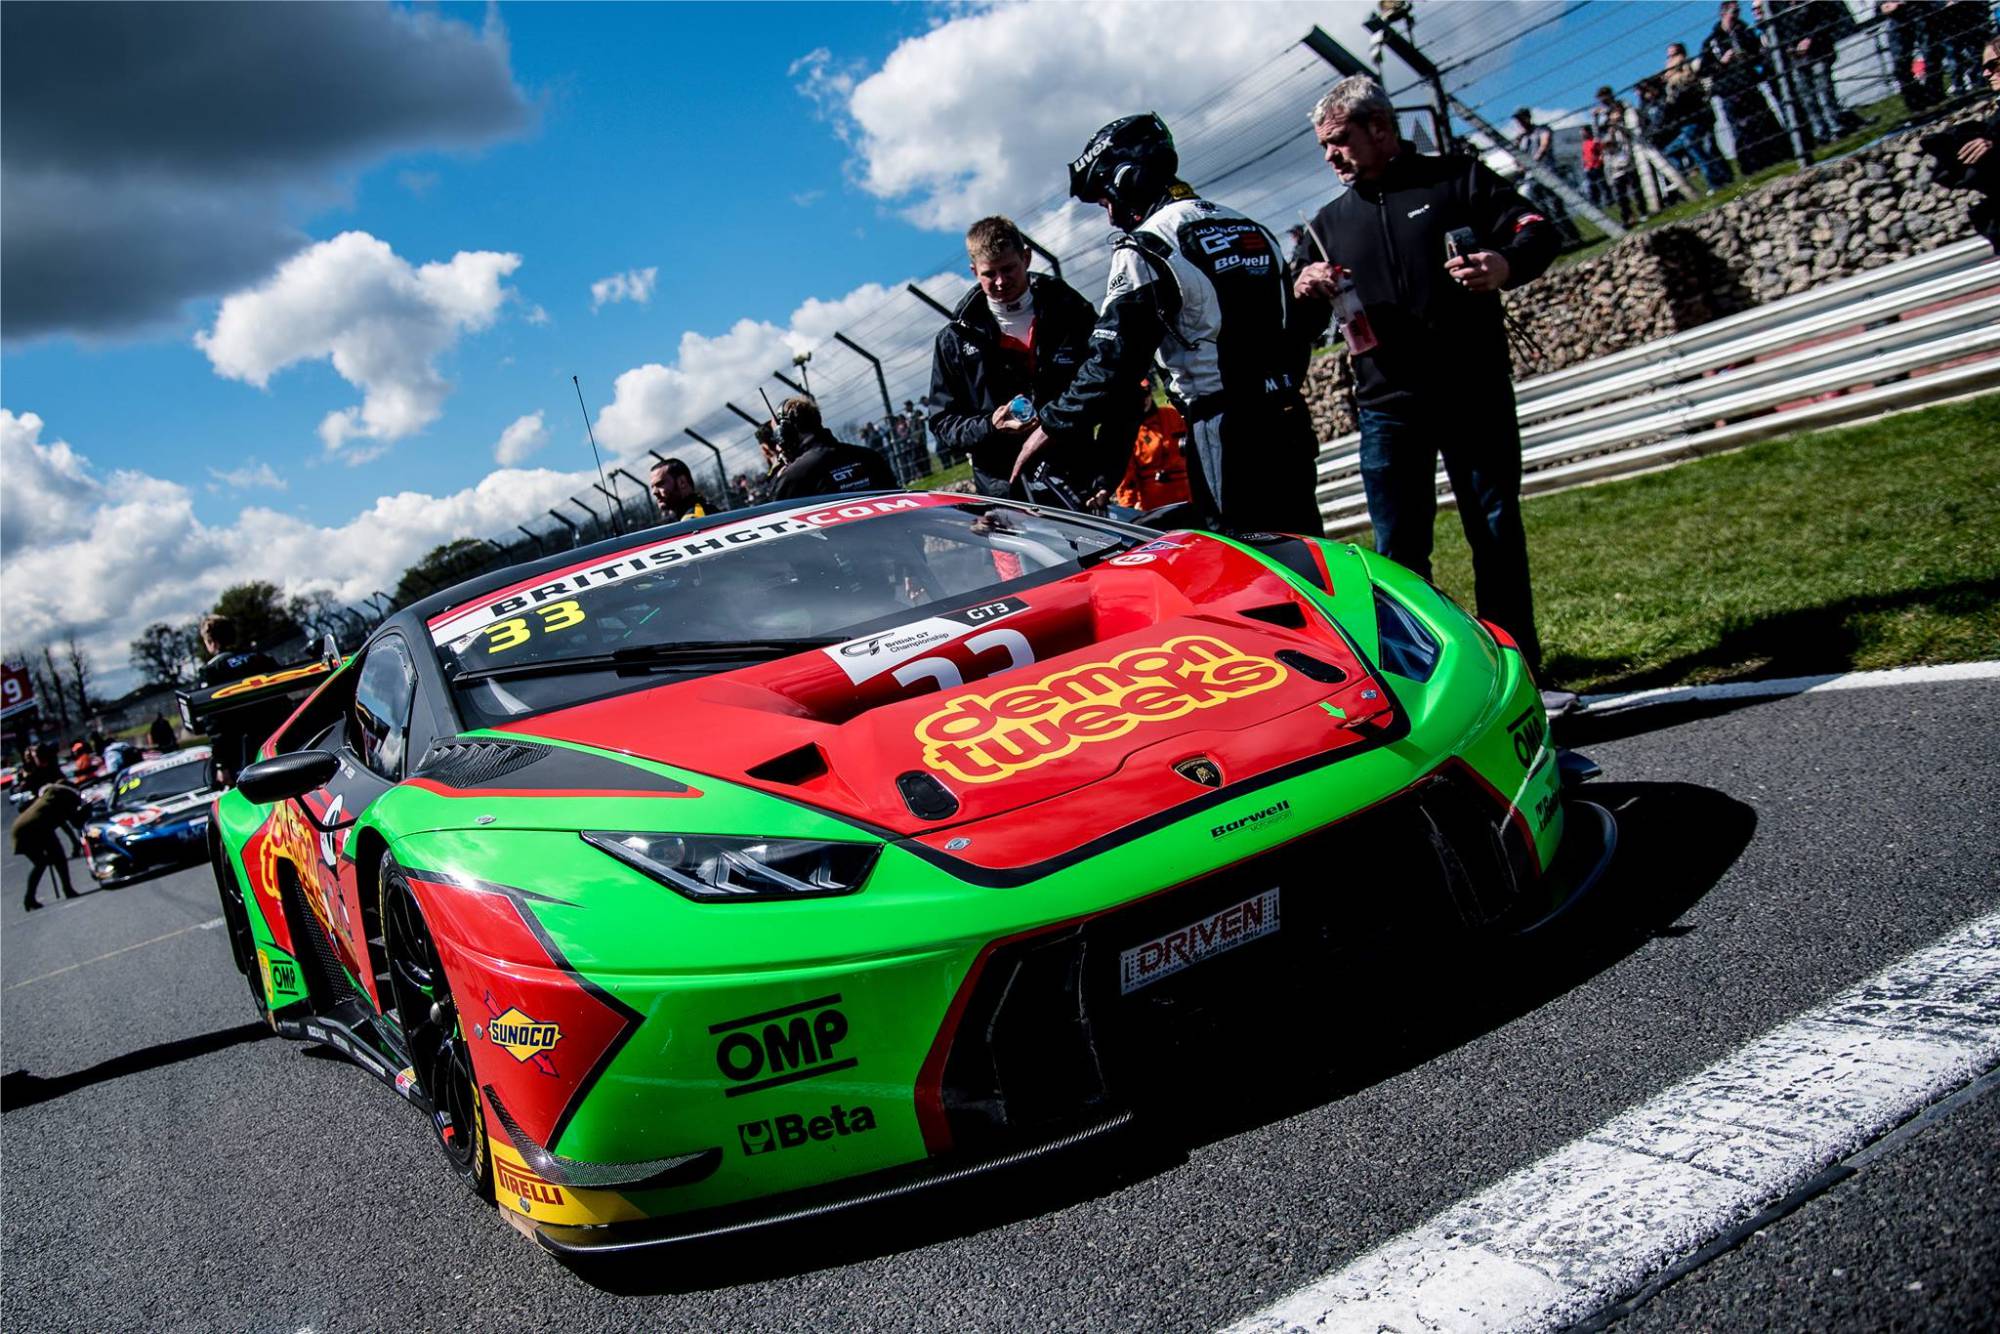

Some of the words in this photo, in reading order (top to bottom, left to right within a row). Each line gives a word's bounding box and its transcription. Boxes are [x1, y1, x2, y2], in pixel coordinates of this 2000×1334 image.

[1073, 136, 1114, 173] uvex
[490, 499, 921, 617] BRITISHGT.COM
[484, 600, 586, 654] 33
[966, 602, 1010, 620] GT3
[884, 636, 915, 649] British
[916, 631, 929, 640] GT
[889, 632, 950, 653] Championship
[924, 639, 1236, 742] demon
[934, 660, 1279, 774] tweeks
[1210, 800, 1290, 838] Barwell
[1138, 896, 1264, 976] DRIVEN
[273, 965, 296, 990] OMP
[491, 1022, 557, 1048] SUNOCO
[716, 1008, 849, 1082] OMP
[774, 1104, 878, 1149] Beta
[494, 1154, 565, 1206] PIRELLI
